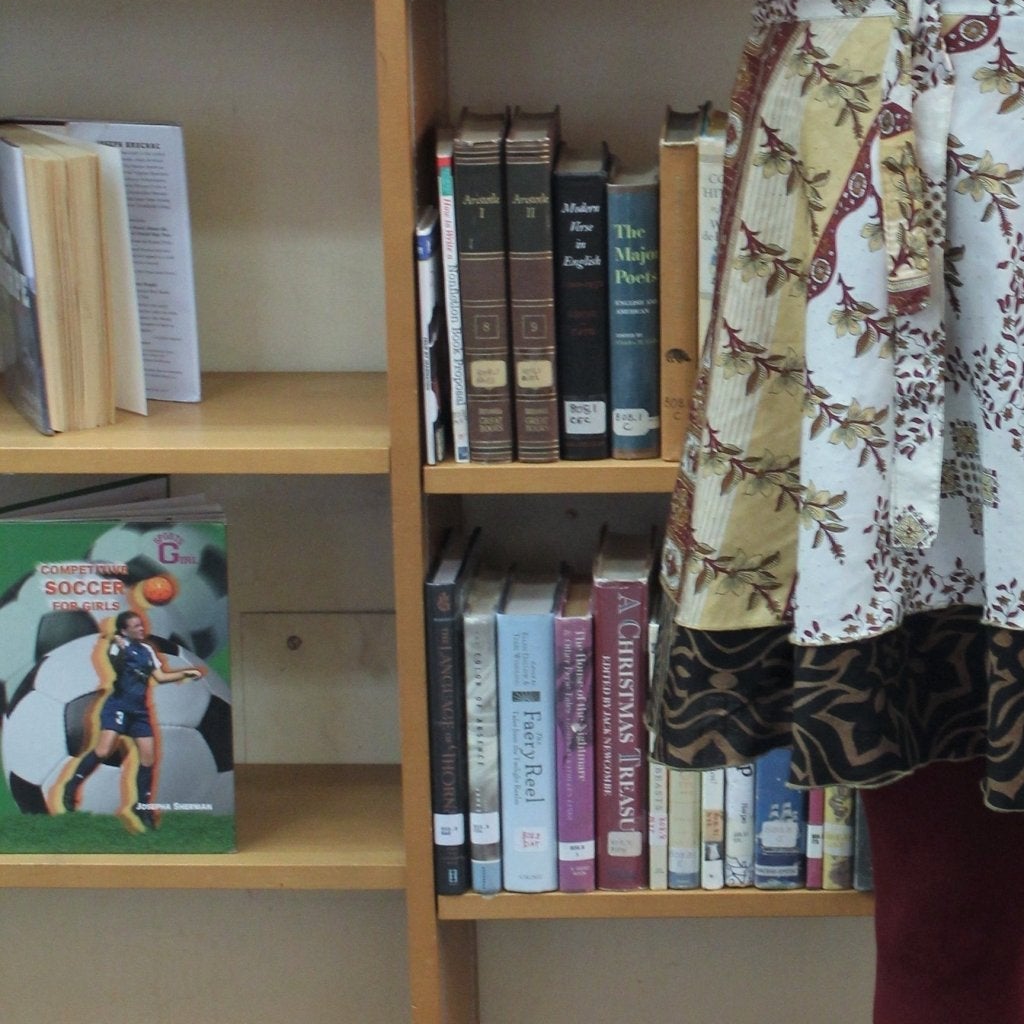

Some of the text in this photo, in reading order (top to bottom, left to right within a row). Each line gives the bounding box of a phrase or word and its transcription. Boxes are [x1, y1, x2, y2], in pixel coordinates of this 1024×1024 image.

[560, 202, 600, 213] Modern
[569, 221, 594, 232] Verse
[613, 224, 646, 239] The
[444, 229, 454, 251] Write
[575, 239, 586, 249] in
[562, 255, 602, 269] English
[614, 246, 658, 266] Majo
[615, 269, 657, 285] Poets
[447, 264, 460, 323] Nonfiction
[450, 326, 462, 352] Book
[451, 357, 465, 405] Proposal
[45, 581, 124, 596] SOCCER
[52, 601, 120, 611] FOR GIRLS
[573, 629, 586, 650] The
[474, 653, 482, 686] COLOR
[574, 652, 587, 687] House
[475, 696, 483, 708] OF
[575, 689, 586, 700] of
[115, 710, 124, 724] 3
[575, 700, 587, 722] the
[617, 593, 641, 831] A CHRISTMAS TREASU
[603, 655, 612, 795] EDITED BY JACK NEWCOMBE
[475, 718, 485, 765] ABSENCE
[519, 710, 545, 803] Faery Reel
[654, 767, 663, 810] BEASTS
